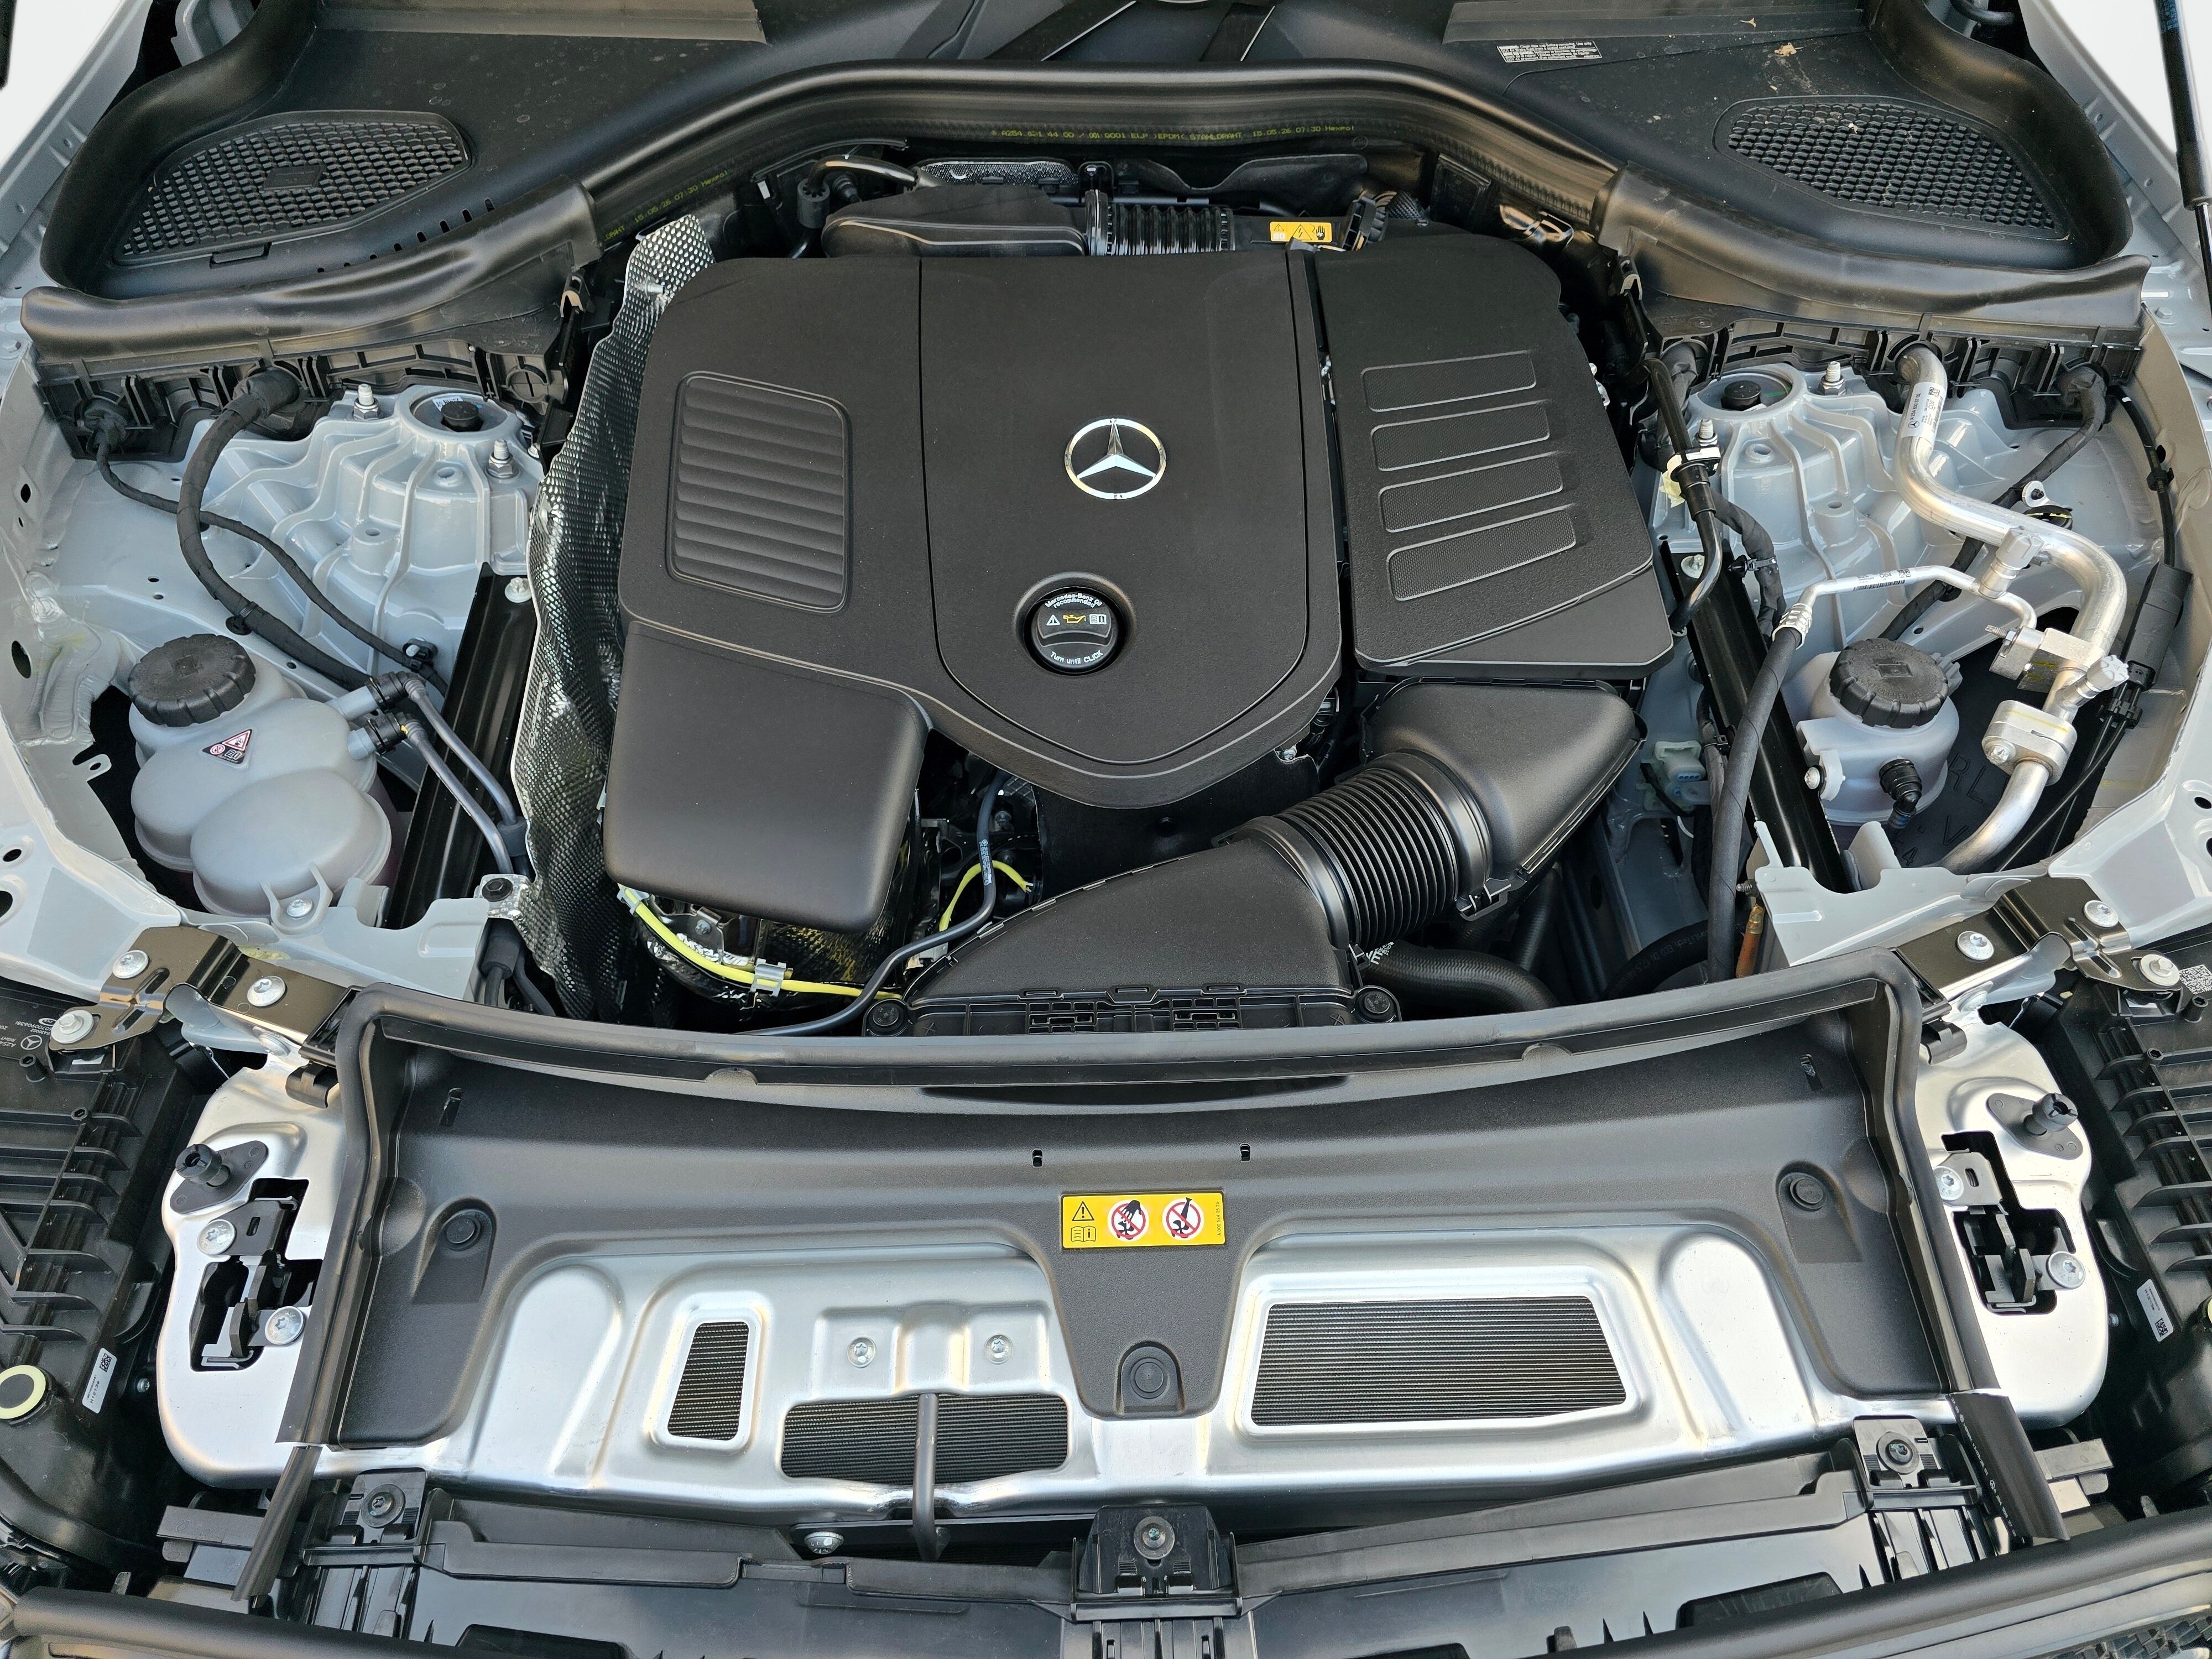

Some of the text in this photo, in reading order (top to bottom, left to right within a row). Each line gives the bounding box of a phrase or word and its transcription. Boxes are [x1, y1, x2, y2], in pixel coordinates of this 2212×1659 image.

[1045, 593, 1094, 608] Mercedes-Benz
[1053, 598, 1096, 608] recommended
[1050, 651, 1065, 663] Turn
[1083, 650, 1103, 663] CLICK
